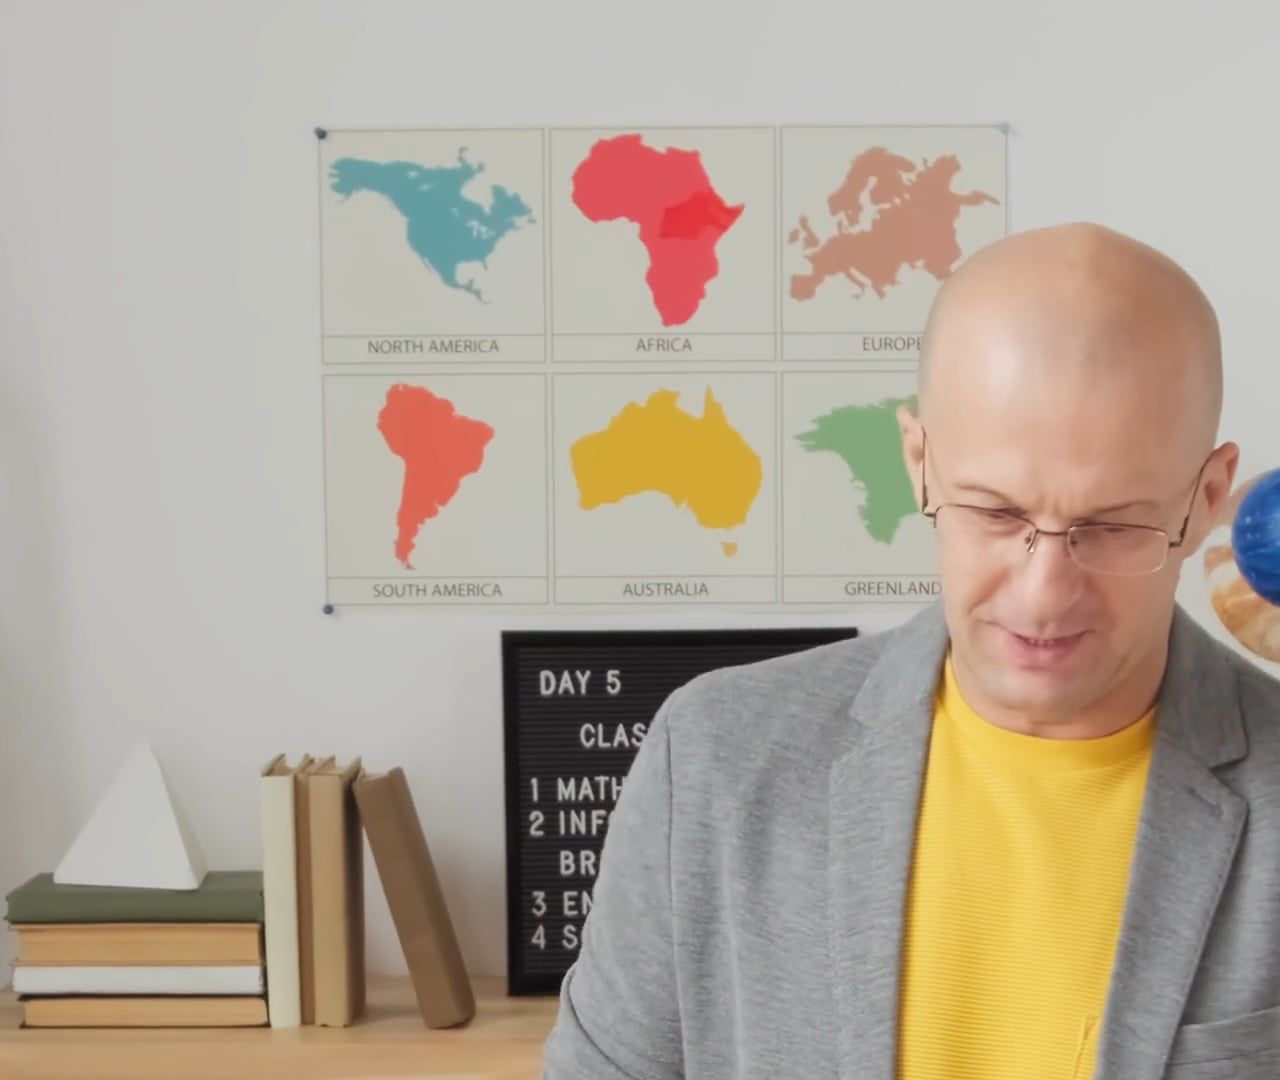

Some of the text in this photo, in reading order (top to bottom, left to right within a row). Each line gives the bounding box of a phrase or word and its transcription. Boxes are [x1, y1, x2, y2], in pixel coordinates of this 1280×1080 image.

[367, 338, 500, 354] NORTH AMERICA
[635, 337, 693, 353] AFRICA
[372, 582, 503, 598] SOUTH AMERICA
[623, 582, 710, 597] AUSTRALIA
[844, 580, 944, 596] GREENLAND
[539, 669, 622, 696] DAY 5
[579, 722, 648, 749] CLAS
[530, 776, 539, 802] 1
[528, 809, 608, 836] 2 INF
[559, 849, 597, 876] BR
[531, 890, 547, 917] 3
[531, 924, 547, 950] 4
